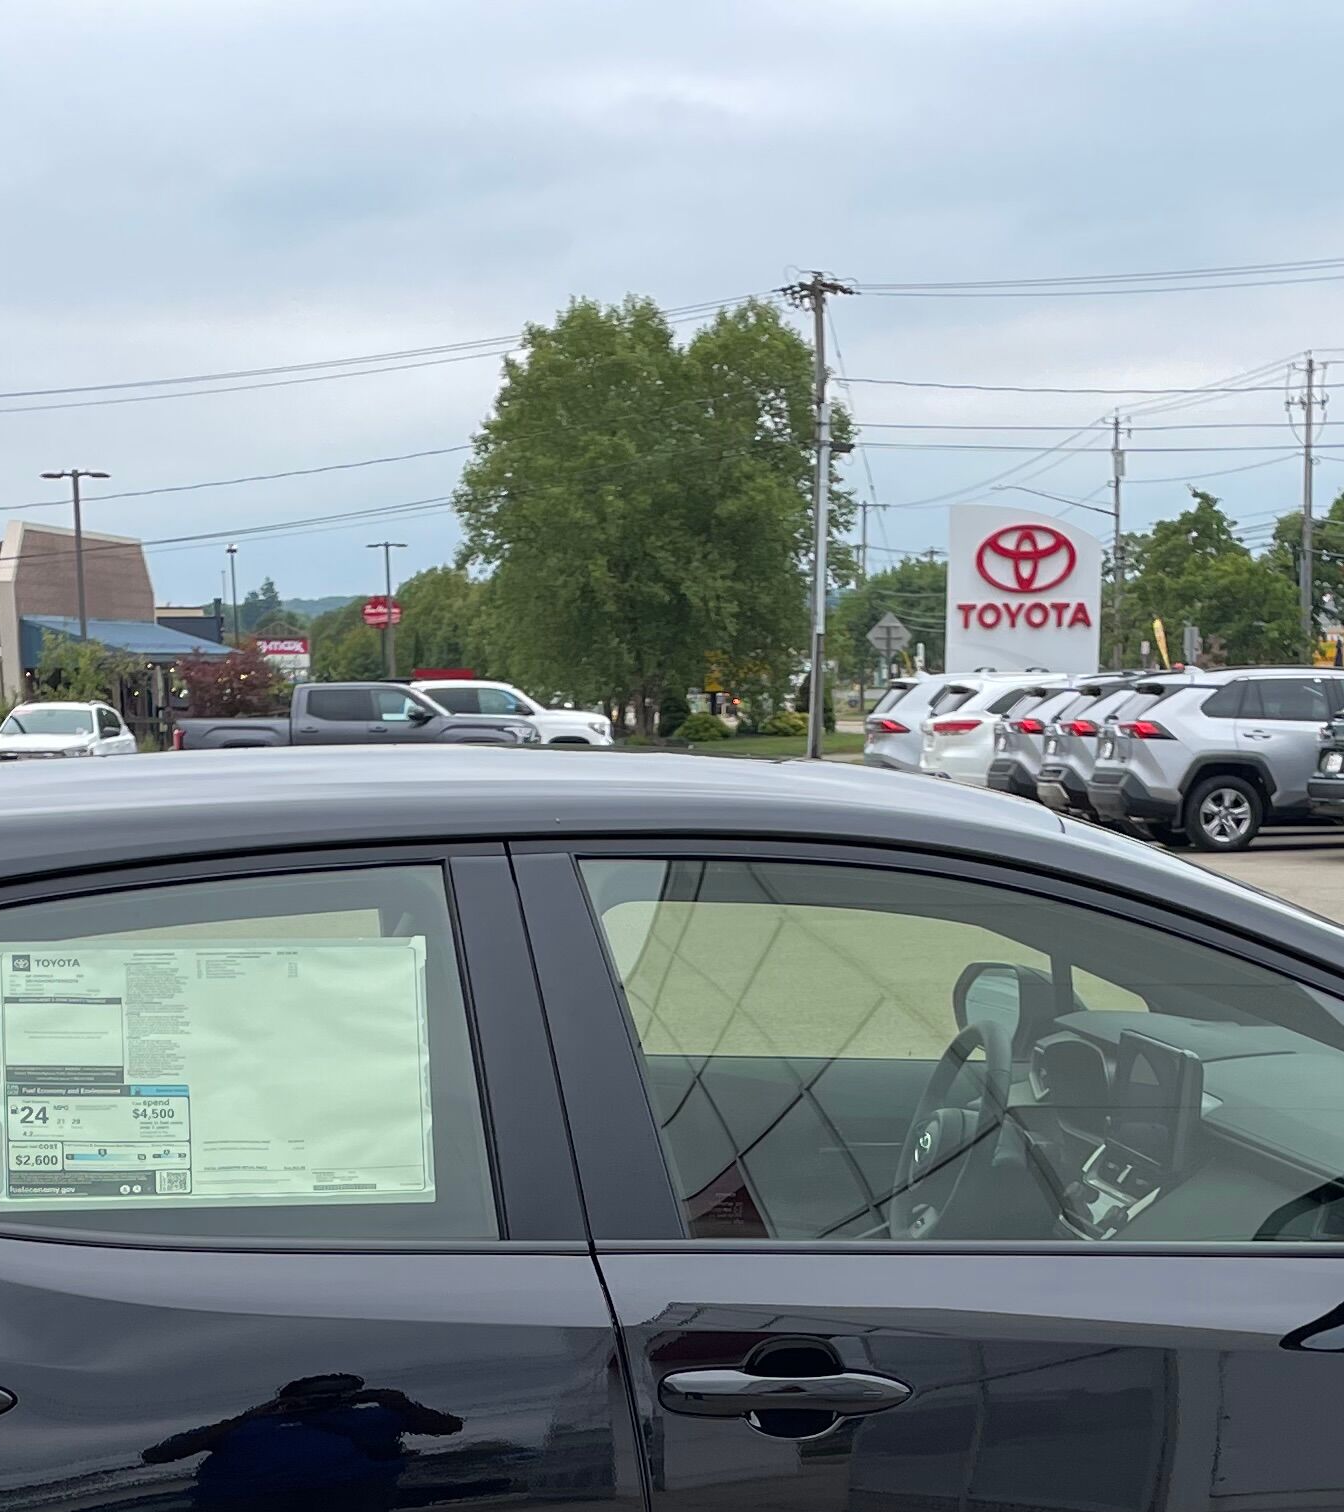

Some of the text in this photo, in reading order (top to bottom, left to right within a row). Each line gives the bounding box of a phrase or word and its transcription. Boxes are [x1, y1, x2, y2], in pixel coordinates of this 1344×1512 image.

[957, 602, 1092, 629] TOYOTA
[35, 959, 81, 968] TOYOTA
[142, 1098, 170, 1107] spend
[20, 1105, 49, 1125] 24
[132, 1108, 175, 1120] $4,500
[15, 1154, 58, 1167] $2,600
